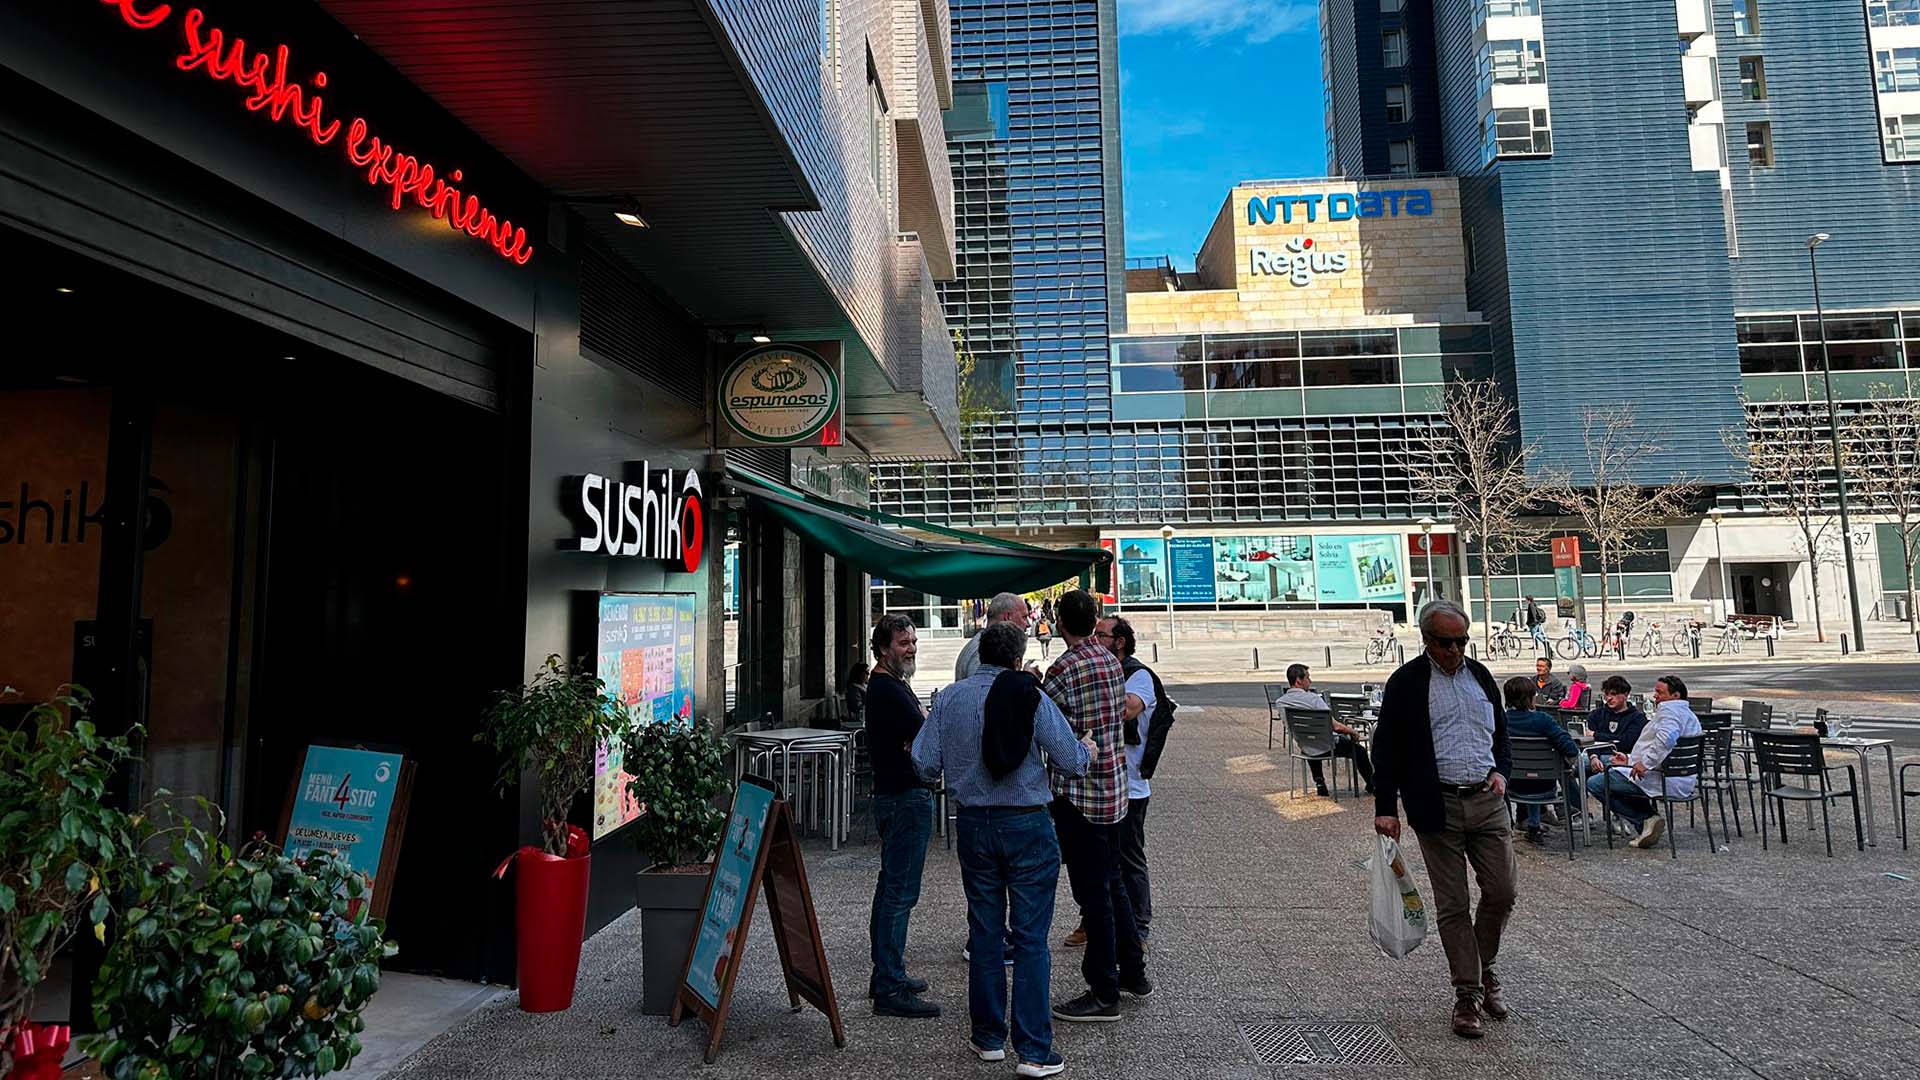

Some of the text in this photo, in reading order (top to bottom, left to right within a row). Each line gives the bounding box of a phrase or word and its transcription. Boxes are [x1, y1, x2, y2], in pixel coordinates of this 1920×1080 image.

[176, 8, 533, 265] sushi experience
[1248, 194, 1323, 225] NTT
[1250, 245, 1349, 287] Regus
[730, 394, 828, 409] espumosos
[1854, 532, 1871, 546] 37
